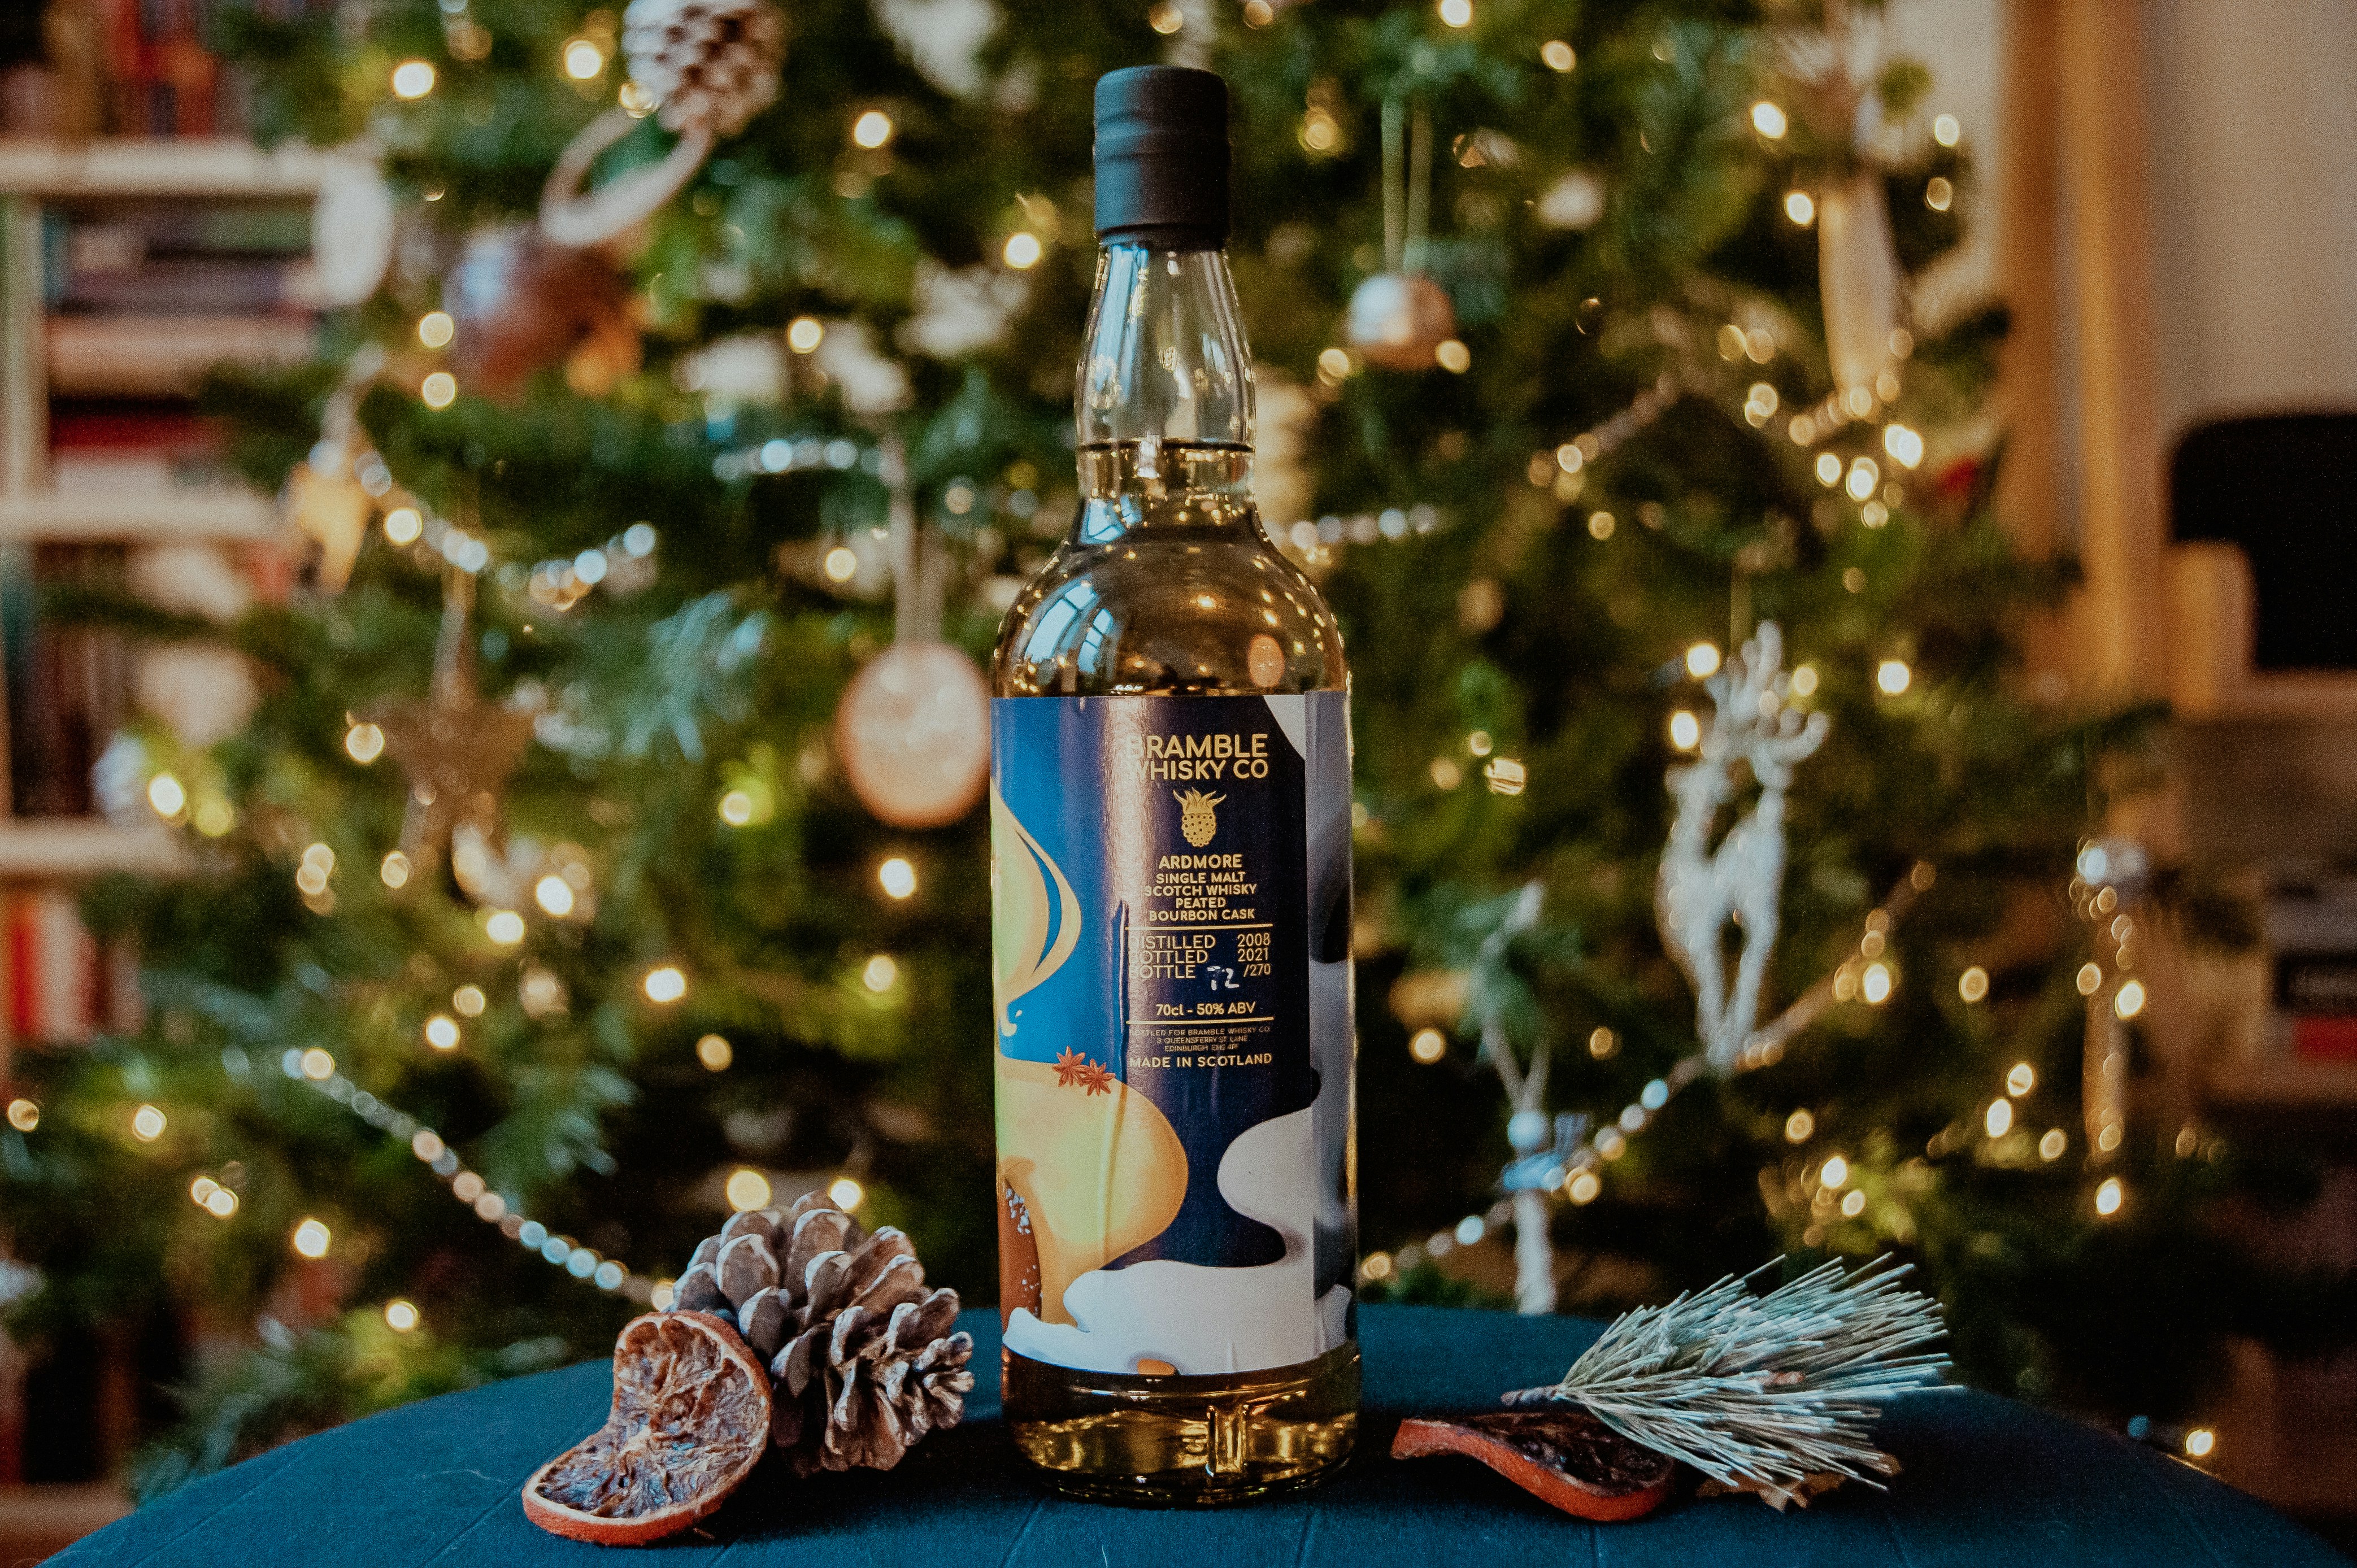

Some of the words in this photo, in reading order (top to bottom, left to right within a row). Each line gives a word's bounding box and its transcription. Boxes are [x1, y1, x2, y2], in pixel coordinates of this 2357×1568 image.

[1127, 734, 1268, 759] BRAMBLE
[1233, 759, 1268, 779] CO
[1158, 854, 1243, 869] ARDMORE
[1156, 873, 1207, 884] SINGLE
[1211, 872, 1246, 883] MALT
[1143, 885, 1202, 896] SCOTCH
[1206, 883, 1258, 896] WHISKY
[1176, 897, 1227, 909] PEATED
[1149, 909, 1217, 921] BOURBON
[1221, 908, 1256, 920] CASK
[1129, 935, 1216, 949] DISTILLED
[1237, 933, 1271, 947] 2008
[1129, 950, 1208, 964] BOTTLED
[1237, 947, 1269, 962] 2021
[1129, 964, 1196, 979] BOTTLE
[1243, 963, 1271, 978] /270
[1156, 1004, 1185, 1016] 70cl
[1197, 1003, 1225, 1016] 50%
[1227, 1001, 1257, 1014] ABV
[1129, 1056, 1171, 1068] MADE
[1176, 1056, 1192, 1068] IN
[1197, 1053, 1272, 1068] SCOTLAND
